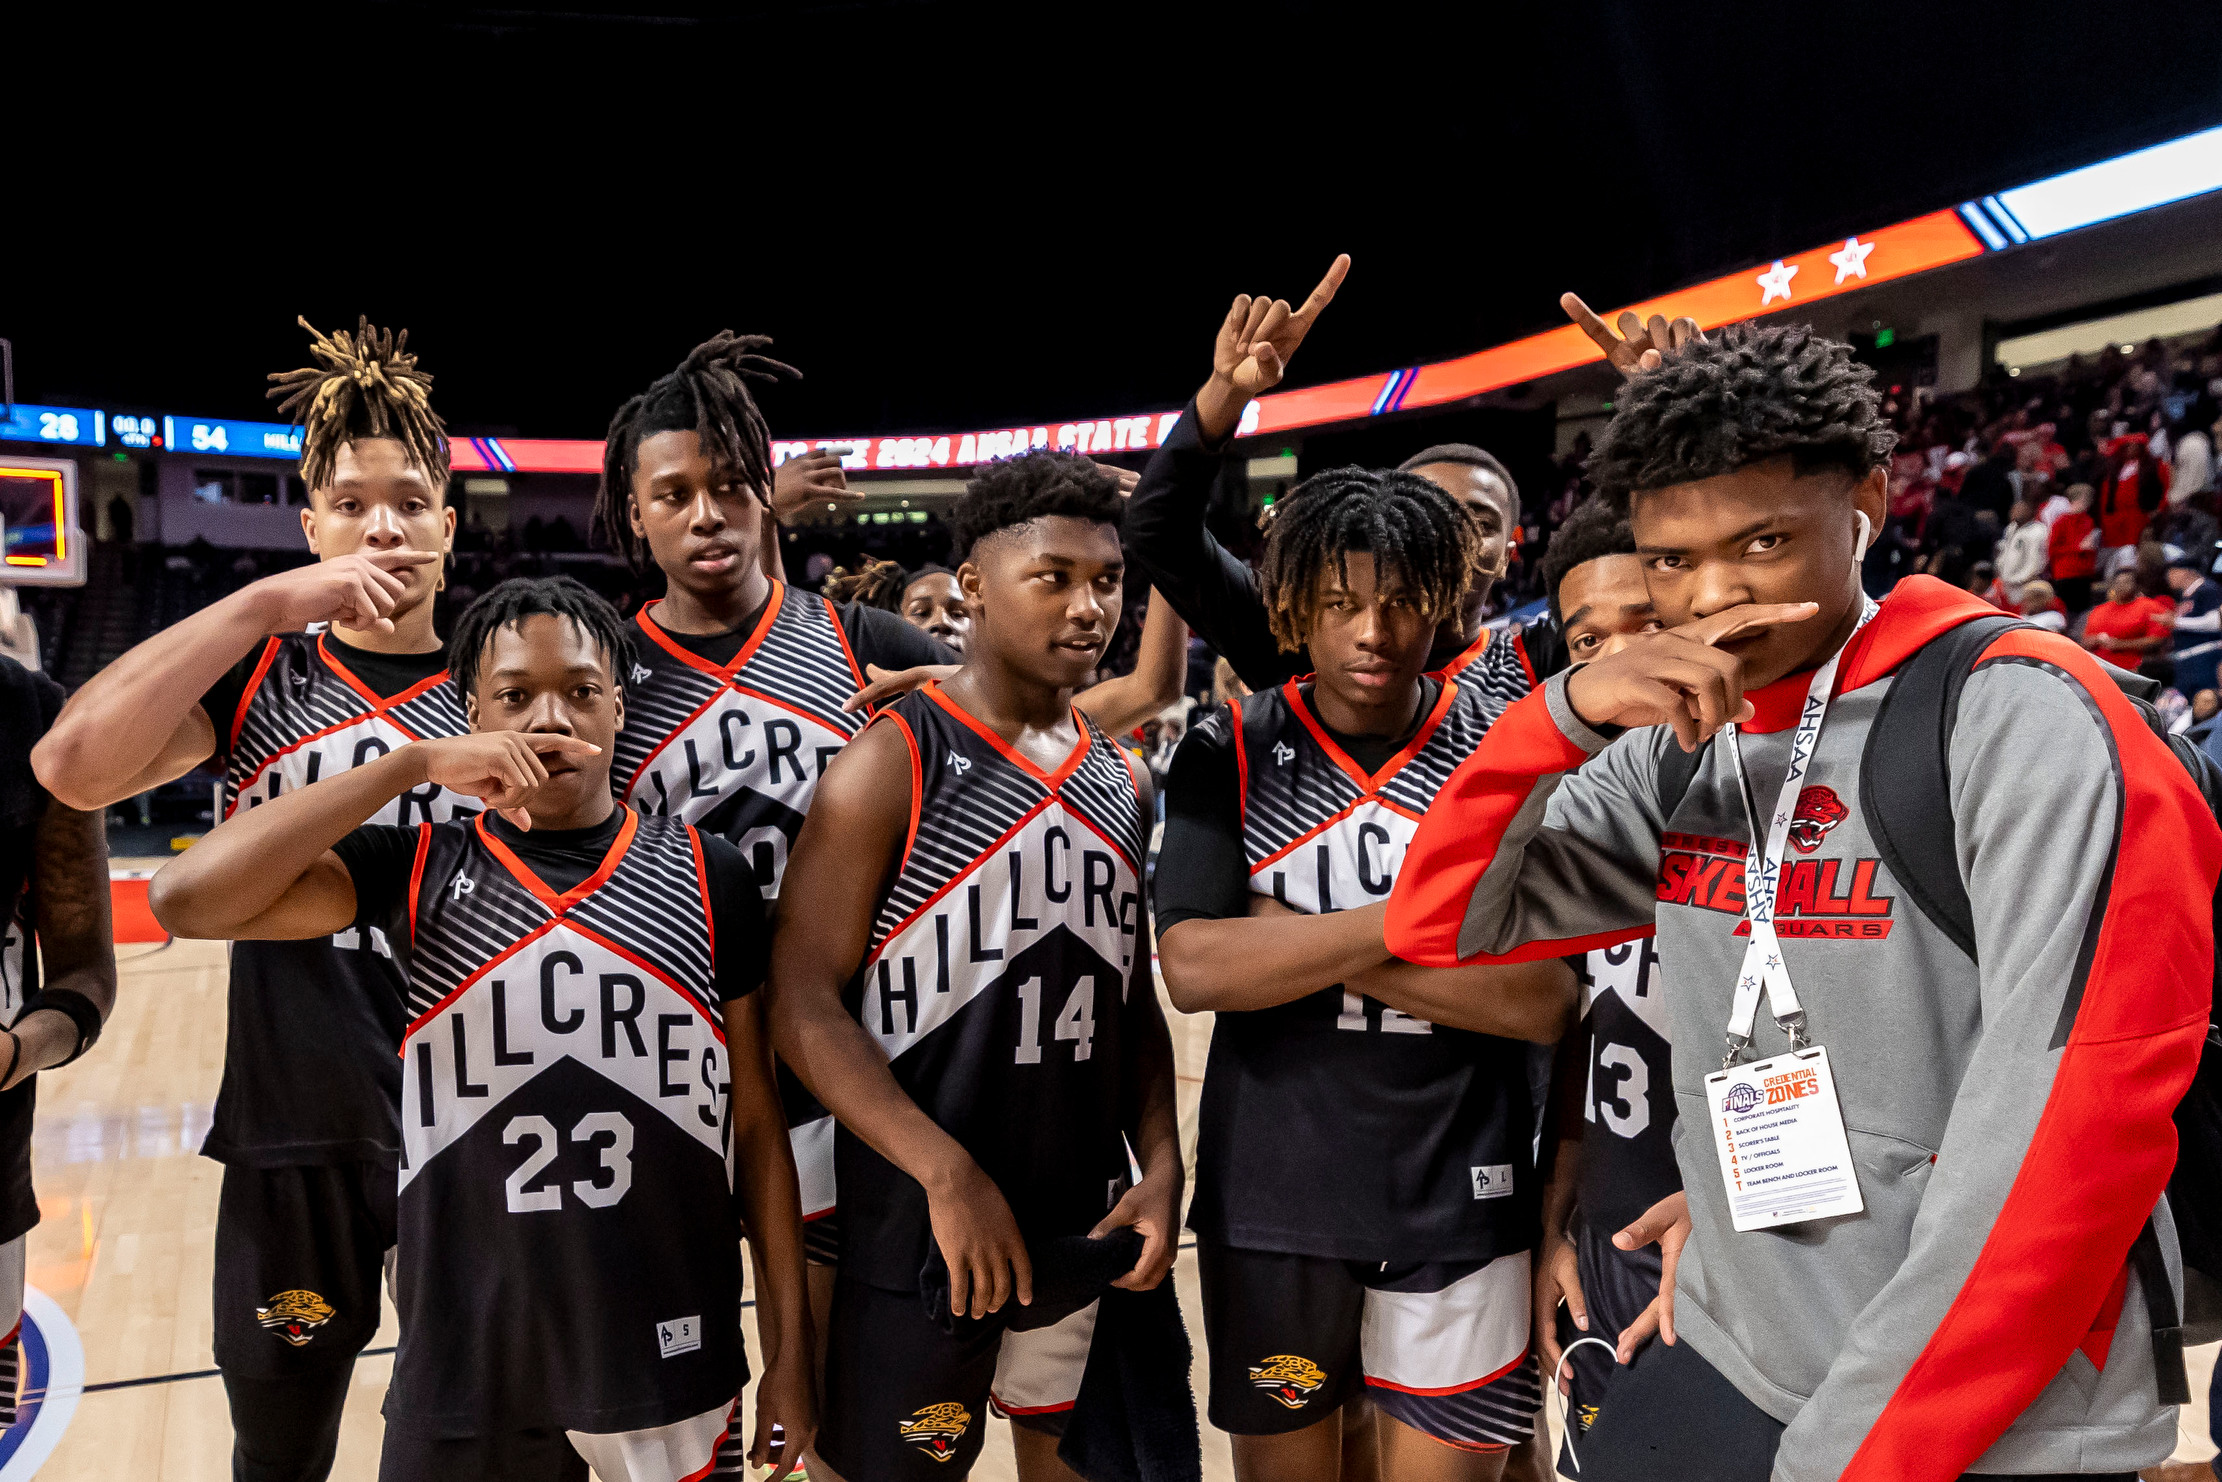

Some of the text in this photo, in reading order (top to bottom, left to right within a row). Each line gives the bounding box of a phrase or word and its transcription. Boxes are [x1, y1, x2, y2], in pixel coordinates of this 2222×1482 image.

[39, 412, 79, 442] 28
[192, 424, 229, 452] 54
[876, 437, 951, 468] 2024
[1057, 416, 1152, 453] STATE
[1786, 695, 1825, 782] AHSAA
[877, 825, 1138, 1035] HILLCRE
[1014, 975, 1096, 1064] 14
[1763, 1067, 1817, 1088] CREDENTIAL
[1722, 1090, 1764, 1113] FINALS
[1765, 1078, 1819, 1105] ZONES
[1723, 1117, 1728, 1128] 1
[1733, 1111, 1765, 1123] CORPORATE
[1765, 1104, 1800, 1116] HOSPITALITY
[1725, 1130, 1732, 1140] 2
[1736, 1128, 1751, 1136] BACK
[1759, 1122, 1779, 1130] HOUSE
[1779, 1118, 1798, 1126] MEDIA
[1728, 1143, 1735, 1153] 3
[1764, 1135, 1780, 1143] TABLE
[1731, 1155, 1738, 1165] 4
[1753, 1148, 1781, 1159] OFFICIALS
[502, 1111, 635, 1213] 23
[1733, 1168, 1740, 1179] 5
[1743, 1165, 1765, 1174] LOCKER
[1735, 1180, 1742, 1191] T
[1746, 1179, 1762, 1187] TEAM
[1762, 1176, 1781, 1184] BENCH
[1795, 1169, 1818, 1178] LOCKER
[1818, 1165, 1839, 1173] ROOM
